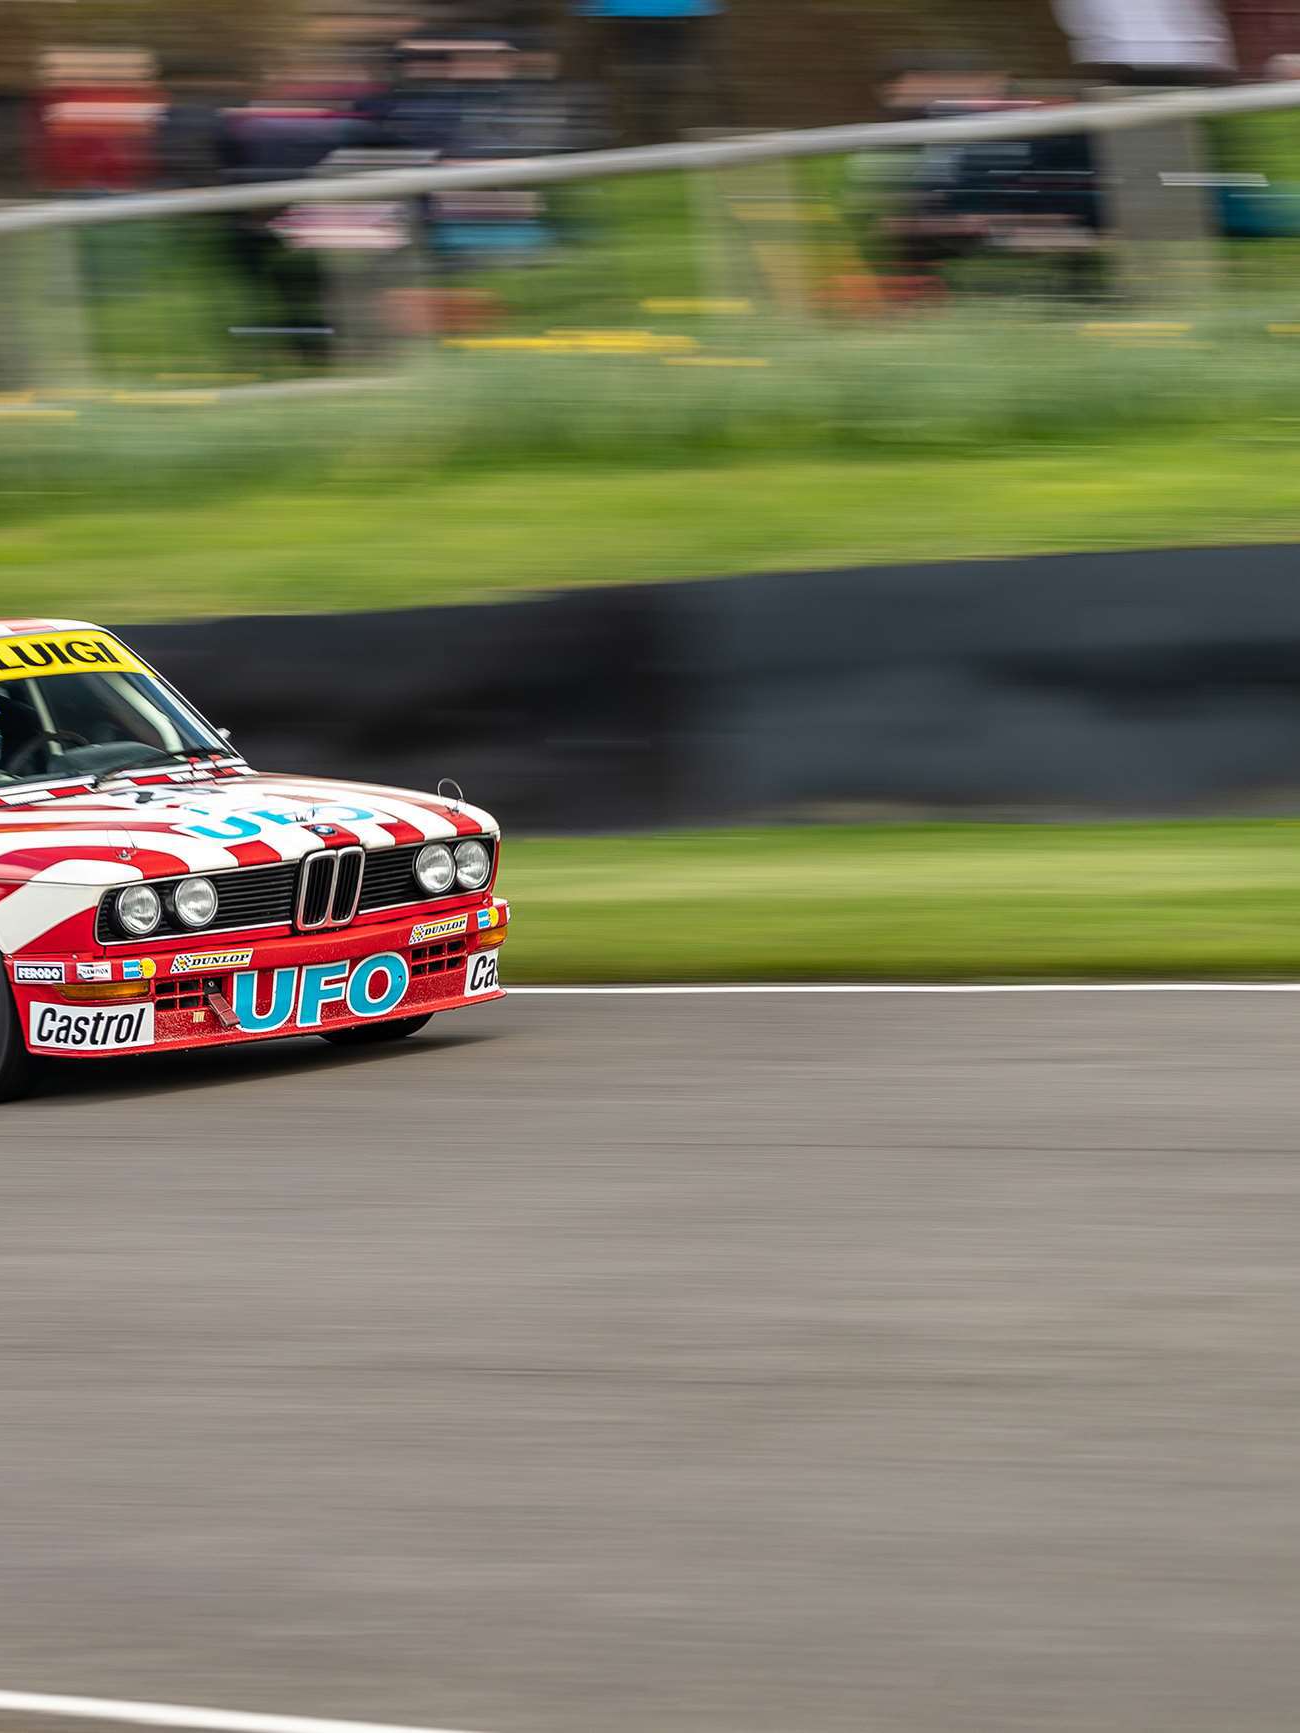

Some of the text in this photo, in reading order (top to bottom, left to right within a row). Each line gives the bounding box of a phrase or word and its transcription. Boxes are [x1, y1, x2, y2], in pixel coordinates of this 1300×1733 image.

[423, 919, 466, 936] DUNLOP
[18, 966, 61, 980] FERODO
[191, 953, 250, 966] DUNLOP
[470, 954, 498, 991] Ca
[233, 951, 409, 1033] UFO
[37, 1007, 146, 1046] Castrol
